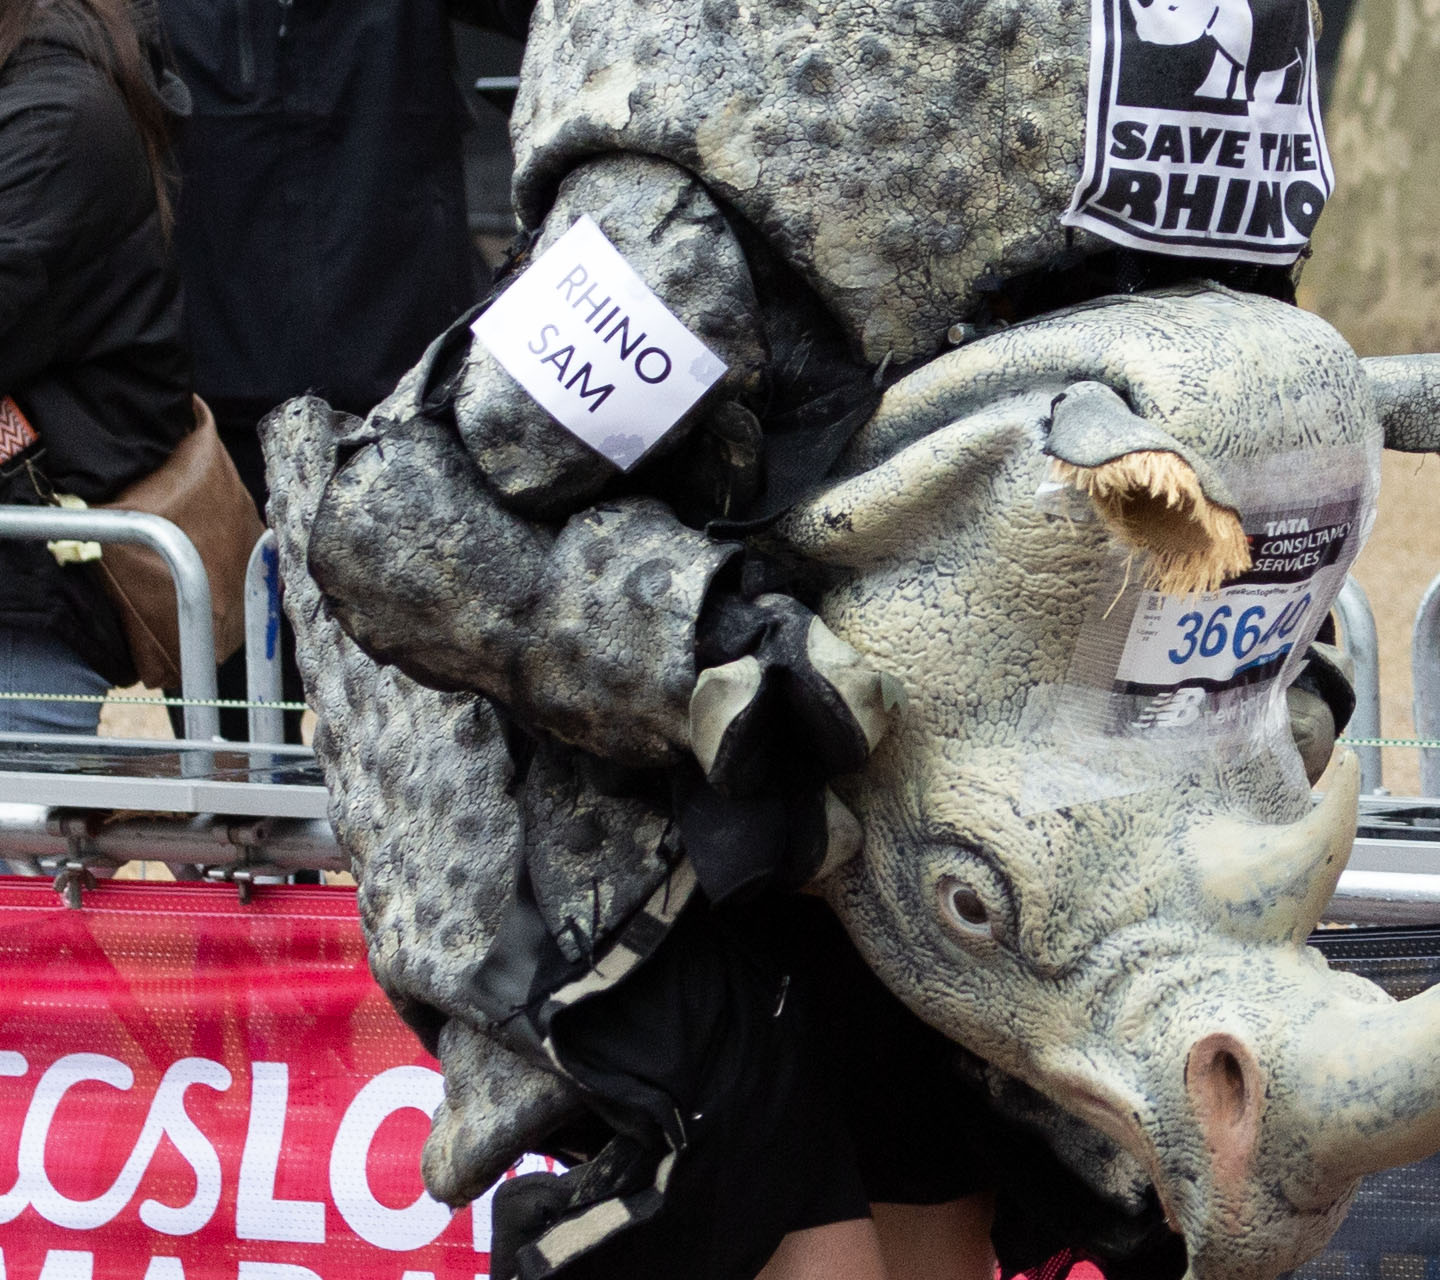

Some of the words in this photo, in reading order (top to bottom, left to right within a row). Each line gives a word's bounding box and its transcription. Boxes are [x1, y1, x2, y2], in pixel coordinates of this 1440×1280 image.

[1109, 119, 1251, 170] SAVE
[1260, 132, 1318, 172] THE
[1095, 166, 1327, 239] RHINO
[555, 263, 672, 385] RHINO
[527, 323, 616, 414] SAM
[1266, 518, 1309, 537] TATA
